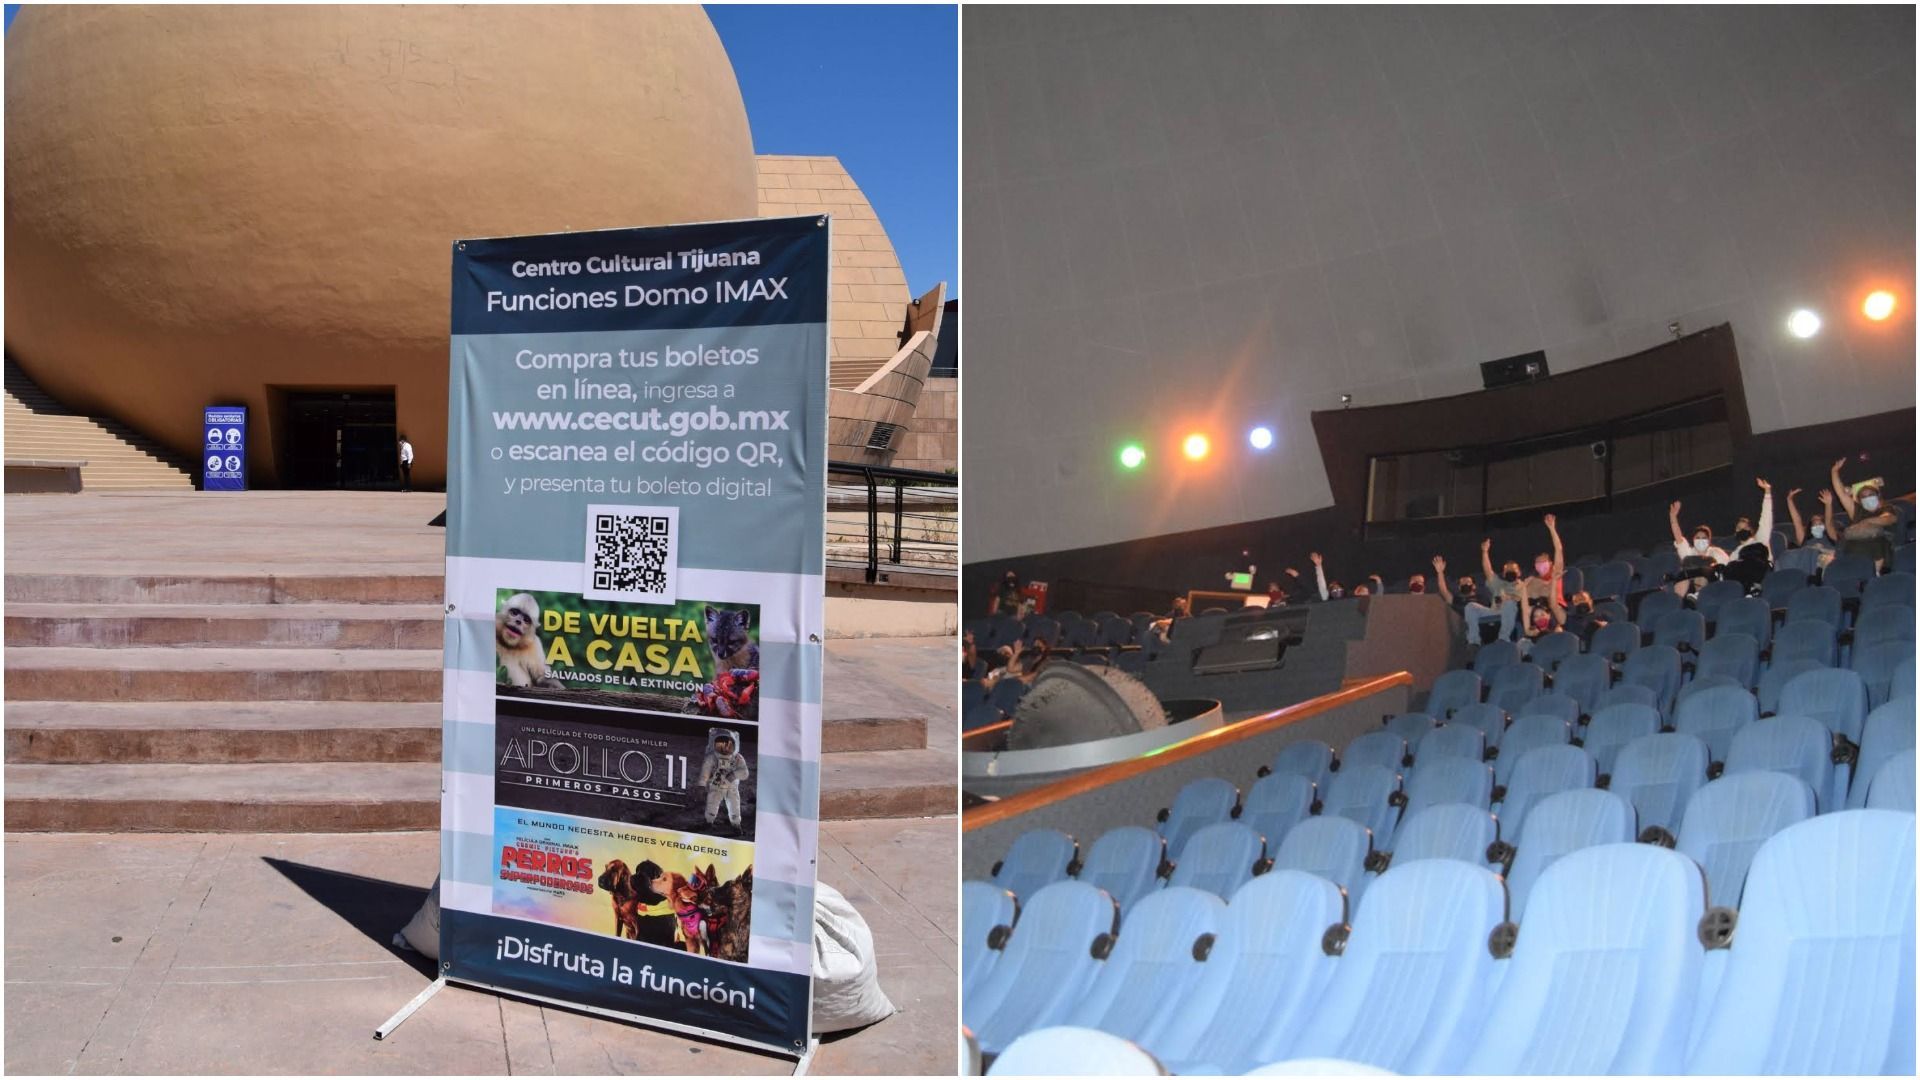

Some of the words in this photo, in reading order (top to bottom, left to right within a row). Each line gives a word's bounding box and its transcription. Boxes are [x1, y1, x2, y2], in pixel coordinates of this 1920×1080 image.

[512, 258, 581, 278] Centro
[586, 252, 672, 275] Cultural
[678, 249, 760, 272] Tijuana
[487, 287, 617, 312] Funciones
[625, 284, 708, 307] Domo
[717, 278, 788, 303] IMAX
[516, 350, 612, 372] Compra
[619, 349, 658, 368] tus
[666, 345, 759, 366] boletos
[537, 382, 567, 399] en
[574, 378, 638, 402] línea,
[644, 381, 718, 402] ingresa
[722, 383, 734, 398] a
[493, 405, 789, 436] www.cecut.gob.mx
[491, 447, 503, 460] o
[509, 443, 607, 462] escanea
[615, 440, 635, 462] el
[642, 439, 728, 468] código
[737, 442, 783, 468] QR,
[504, 479, 517, 495] y
[521, 476, 604, 498] presenta
[610, 478, 630, 493] tu
[637, 476, 700, 495] boleto
[706, 477, 771, 499] digital
[544, 610, 580, 632] DE
[589, 614, 702, 643] VUELTA
[546, 636, 574, 666] A
[586, 640, 703, 678] CASA
[545, 671, 602, 683] SALVADOS
[605, 675, 619, 685] DE
[623, 676, 637, 686] LA
[640, 677, 703, 692] EXTINCIÓN
[538, 727, 570, 737] PELÍCULA
[584, 732, 603, 740] TODD
[606, 734, 639, 744] DOUGLAS
[642, 738, 668, 747] MILLER
[500, 737, 653, 783] APOLLO
[665, 754, 687, 790] 11
[526, 776, 602, 792] PRIMEROS
[613, 787, 662, 801] PASOS
[531, 820, 564, 831] MUNDO
[568, 825, 614, 838] NECESITA
[618, 832, 656, 845] HÉROES
[660, 840, 728, 857] VERDADEROS
[501, 846, 593, 880] PERROS
[500, 869, 593, 894] SUPERPODEROSOS
[496, 937, 604, 978] ¡Disfruta
[612, 958, 632, 985] la
[640, 965, 755, 1009] función!
